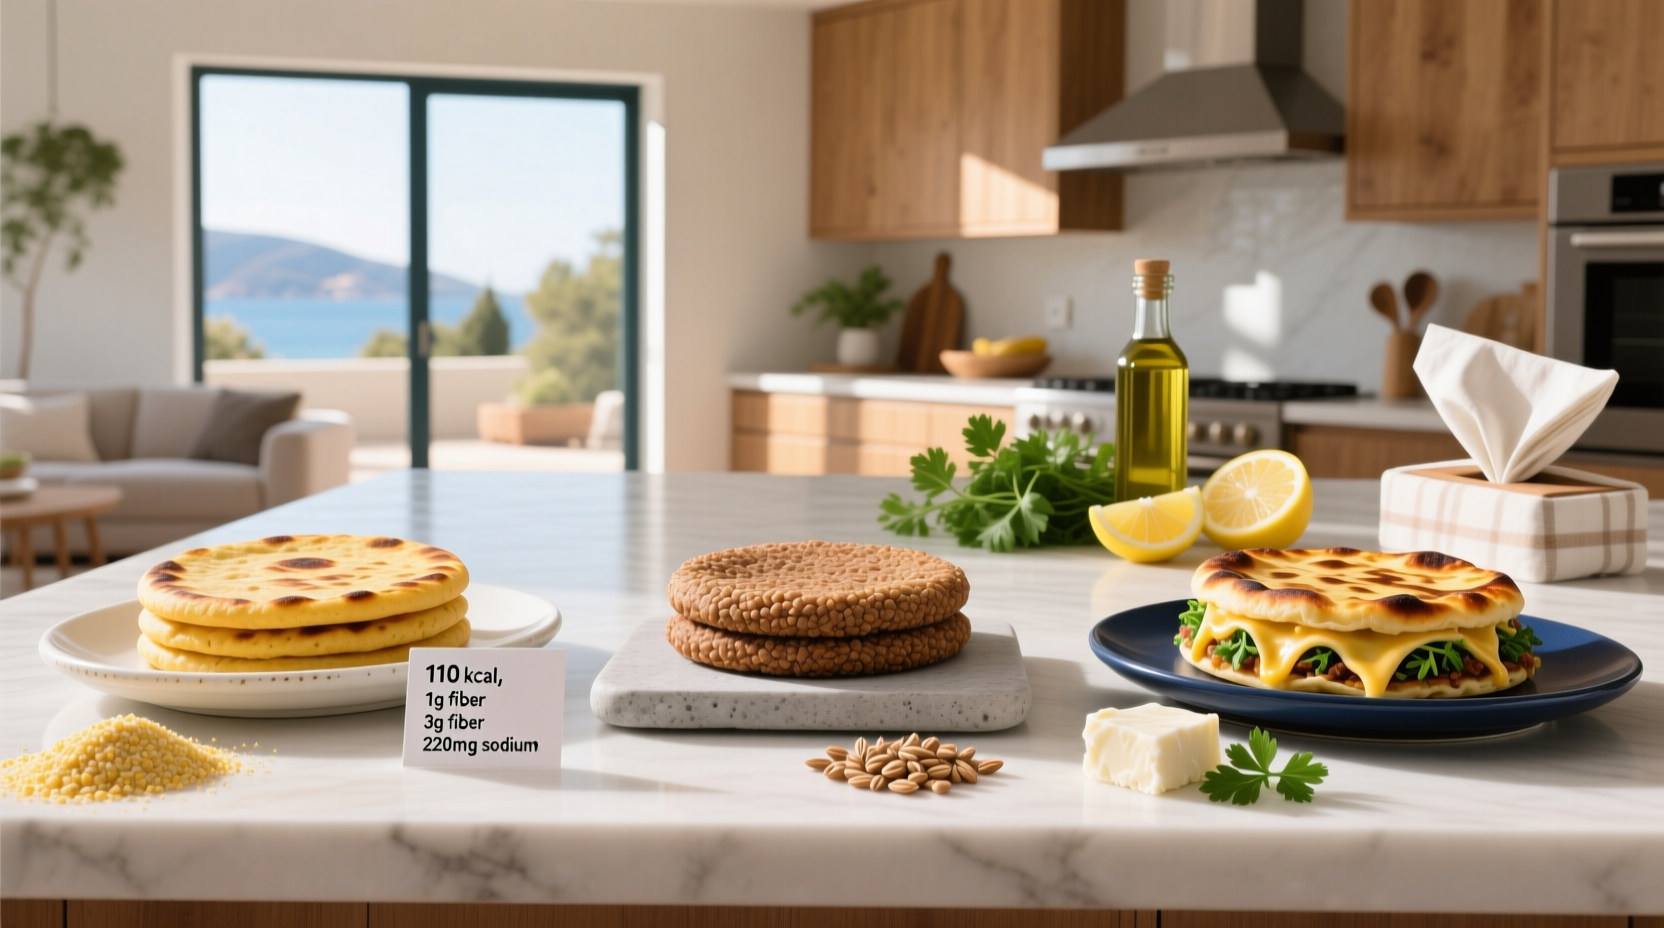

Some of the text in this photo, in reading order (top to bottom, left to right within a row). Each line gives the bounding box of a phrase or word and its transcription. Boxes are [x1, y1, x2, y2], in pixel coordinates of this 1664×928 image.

[426, 664, 502, 687] 110 kcal,
[426, 690, 486, 711] 1g fiber
[424, 714, 485, 733] 3g fiber
[423, 737, 538, 756] 220mg sodium
